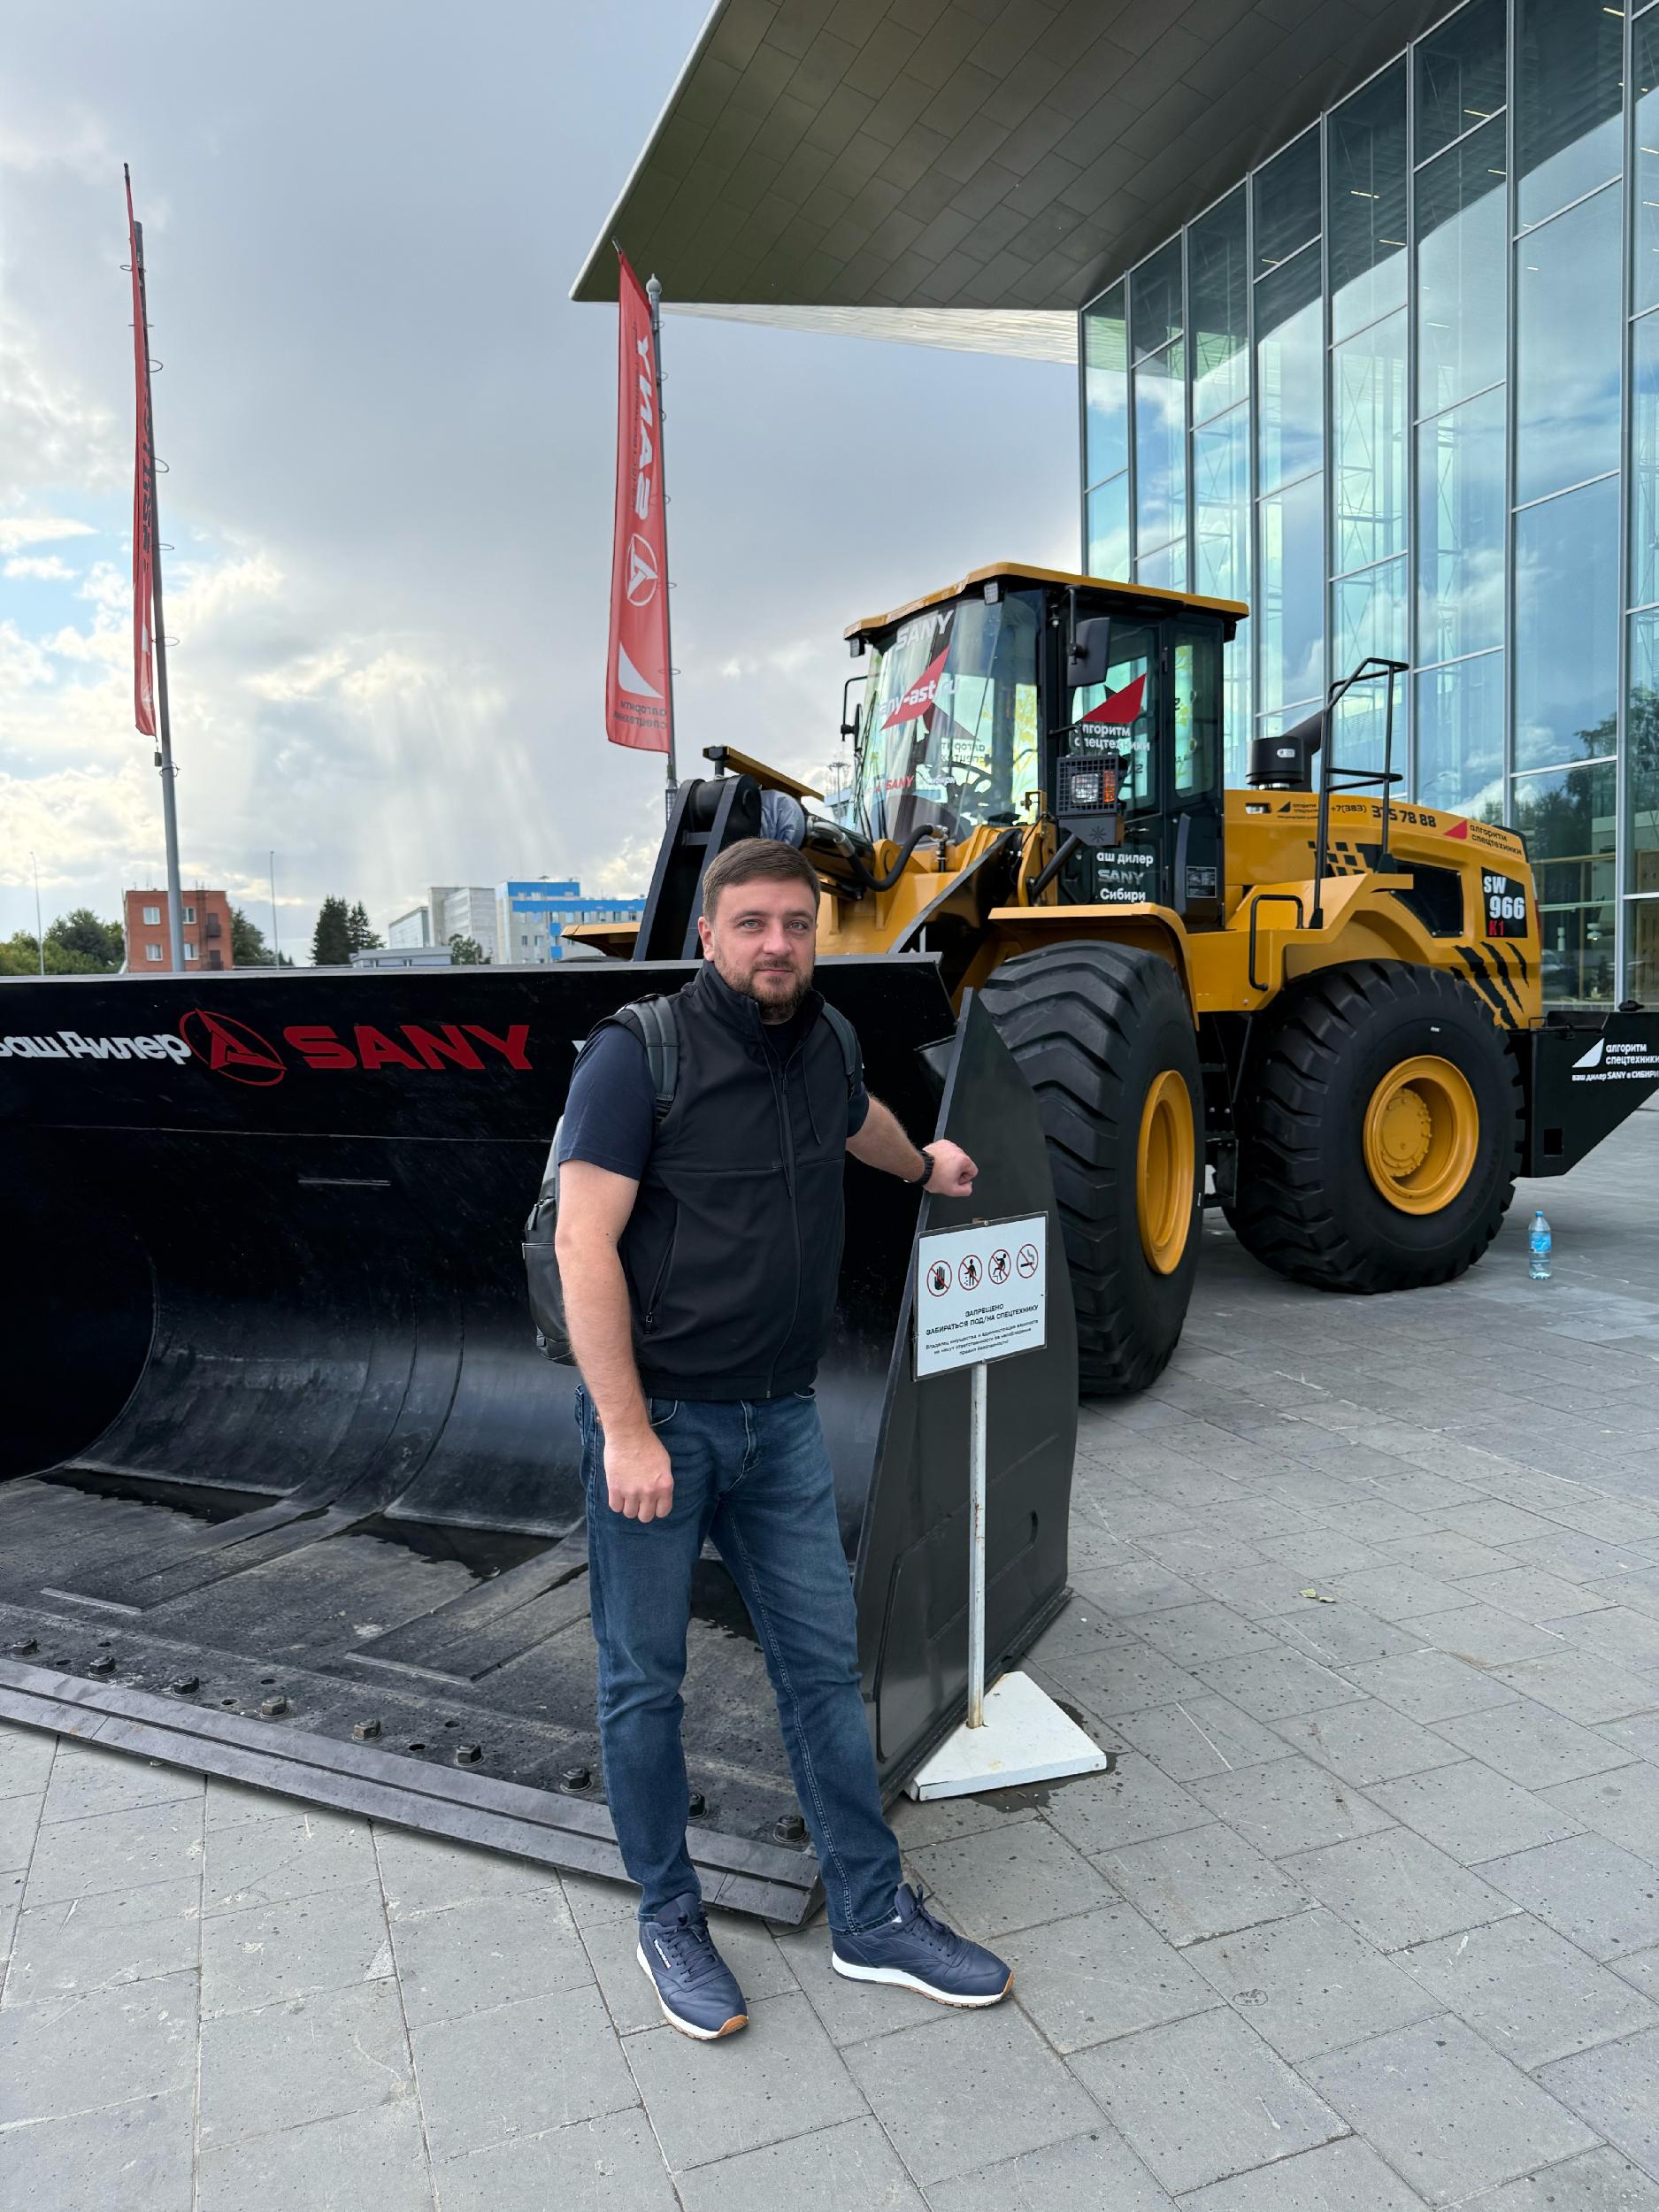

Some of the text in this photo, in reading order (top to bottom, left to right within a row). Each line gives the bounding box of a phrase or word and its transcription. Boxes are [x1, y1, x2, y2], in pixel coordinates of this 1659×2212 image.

[895, 609, 955, 651] SANY
[1074, 723, 1131, 737] лгоритм
[886, 775, 915, 793] SANY
[1331, 803, 1437, 828] +7(383) 35 78 88
[1470, 825, 1508, 841] алгоритм
[1471, 834, 1523, 856] спецтехники
[1117, 853, 1154, 867] дилер
[1097, 869, 1145, 886] SANY
[1483, 875, 1507, 895] SW
[1100, 887, 1147, 902] Сибири
[1489, 895, 1525, 920] 966
[1488, 919, 1504, 936] K1
[283, 1024, 534, 1070] SANY
[1606, 1044, 1647, 1055] алгоритм
[1606, 1056, 1659, 1065] спецтехники
[1607, 1071, 1626, 1079] SANY
[964, 1303, 1004, 1317] ЗАПРЕЩЕНО
[926, 1320, 969, 1335] ЗАБИРАТЬСЯ
[996, 1304, 1039, 1319] СПЕЦТЕХНИКУ
